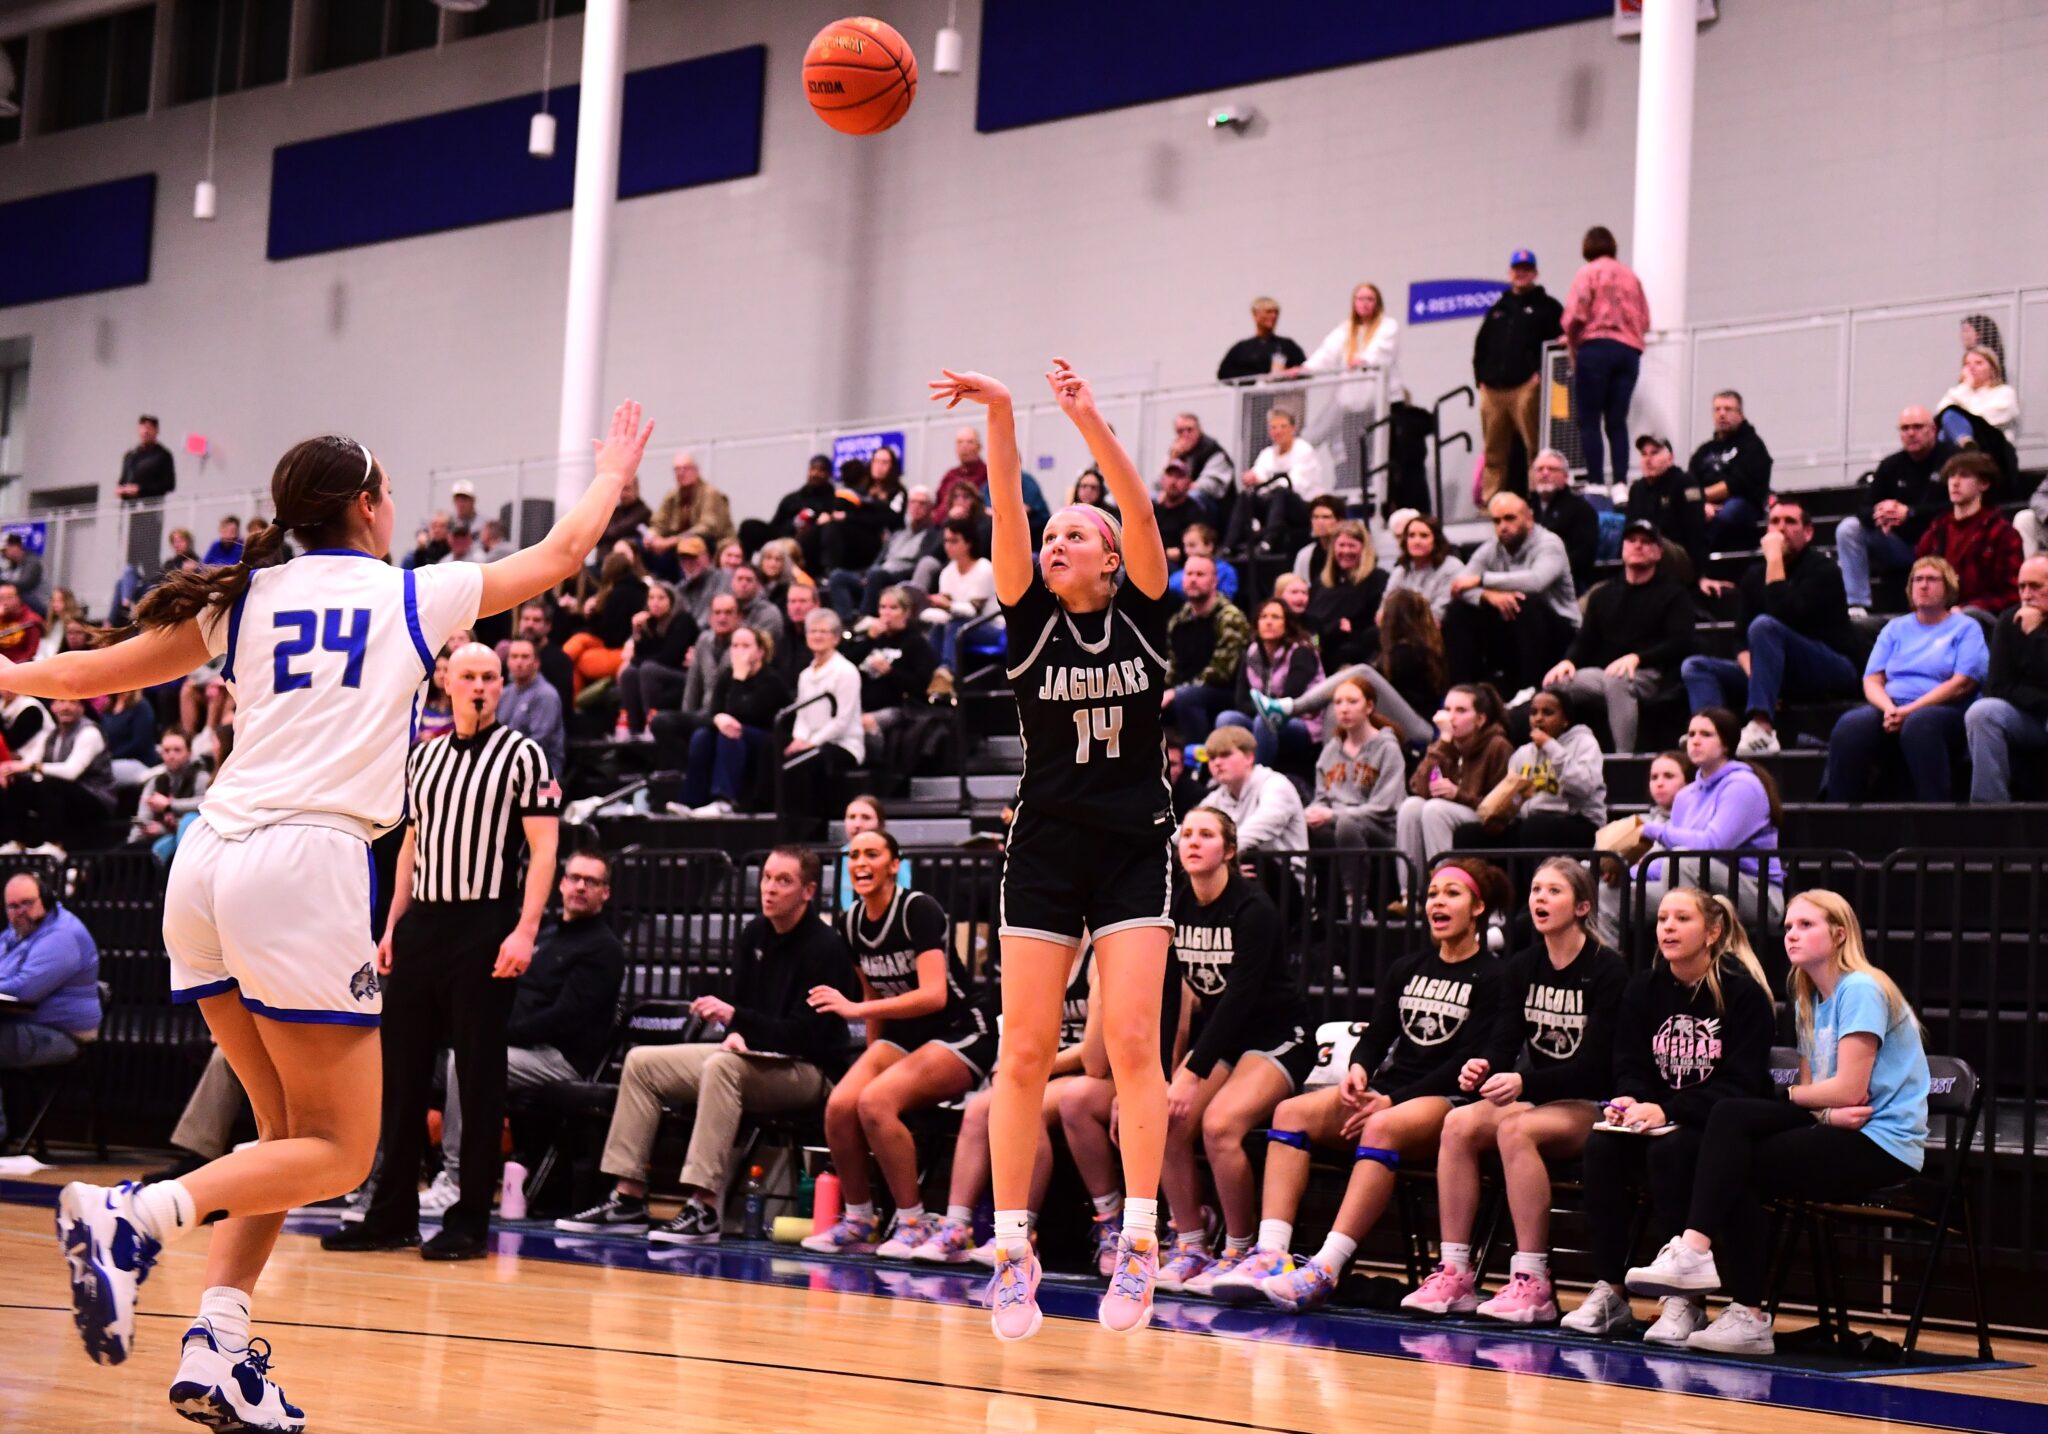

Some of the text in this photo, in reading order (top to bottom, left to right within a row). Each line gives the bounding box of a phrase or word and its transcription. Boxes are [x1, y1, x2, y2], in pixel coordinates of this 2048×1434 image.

[807, 80, 845, 95] WOLVES
[272, 608, 372, 694] 24
[1038, 656, 1149, 701] JAGUARS
[1072, 706, 1123, 764] 14
[1174, 924, 1233, 951] JAGUAR
[1403, 974, 1473, 1006] JAGUAR
